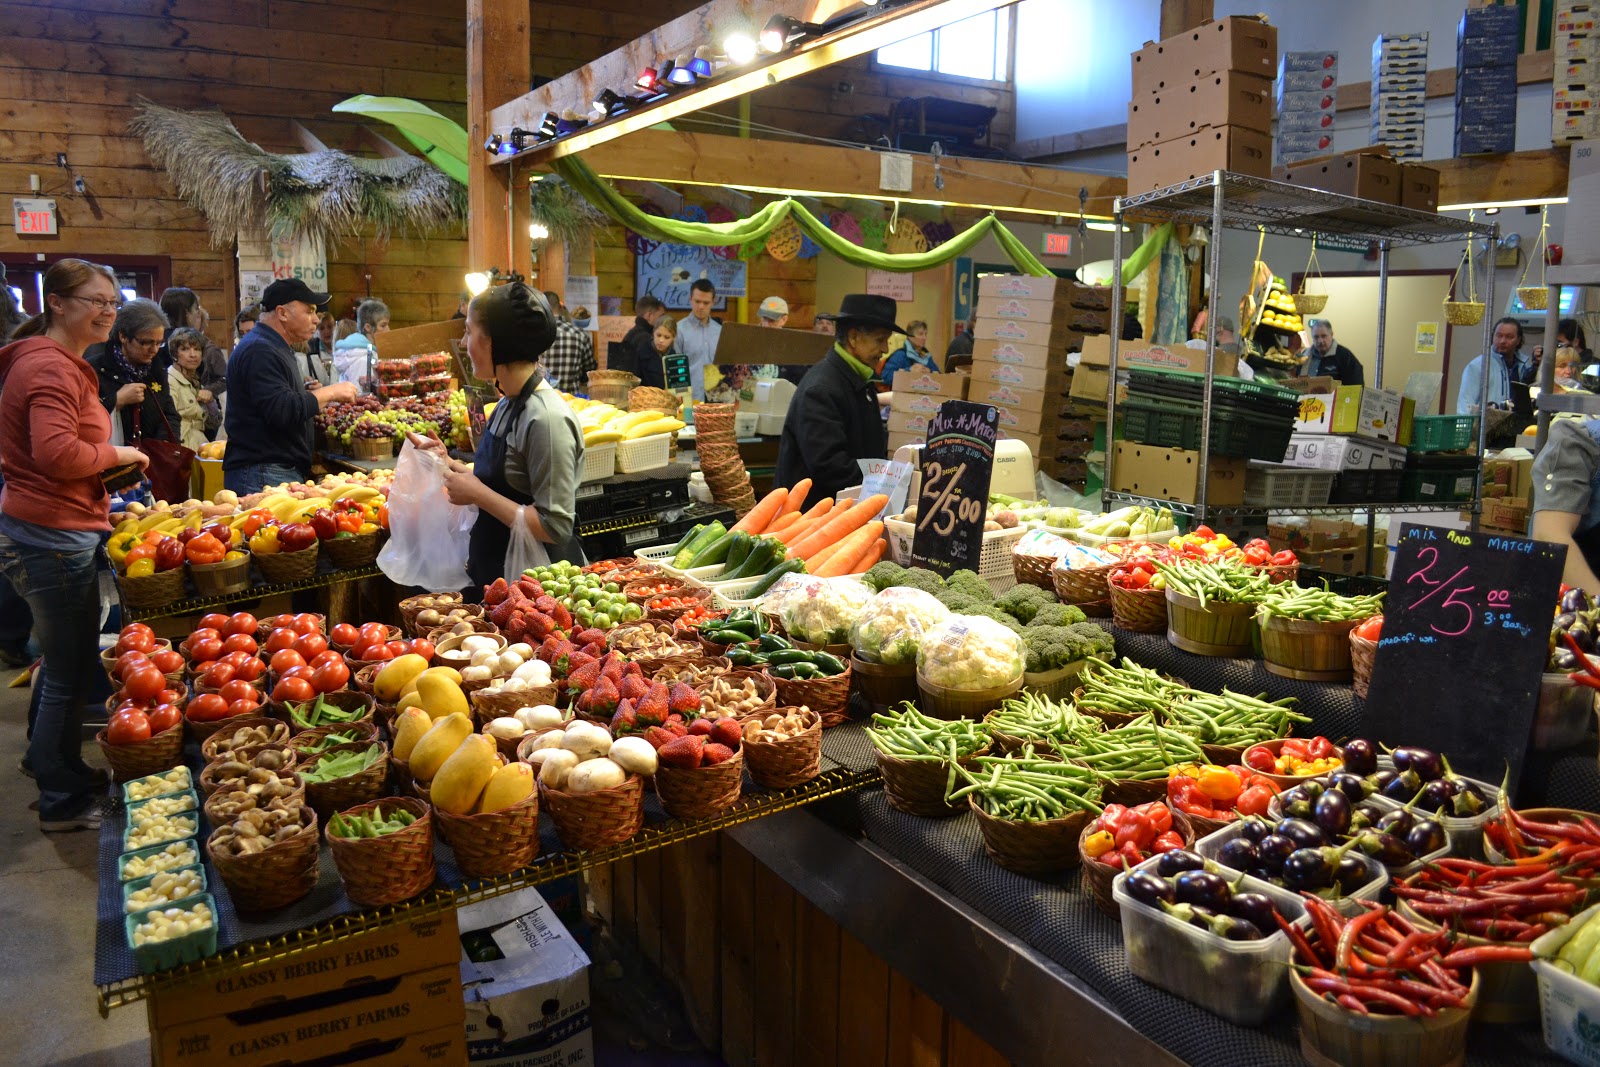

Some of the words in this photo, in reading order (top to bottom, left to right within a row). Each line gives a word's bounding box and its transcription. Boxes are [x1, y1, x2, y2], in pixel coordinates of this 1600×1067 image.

[1577, 148, 1592, 158] 500
[21, 211, 50, 232] EXIT
[1047, 233, 1069, 253] EXIT
[951, 445, 965, 453] STOP
[966, 447, 982, 459] SHOP
[1447, 530, 1472, 545] AND
[1488, 538, 1534, 553] MATCH
[410, 919, 442, 930] Consumer
[216, 970, 278, 994] CLASSY
[283, 956, 339, 980] BERRY
[344, 942, 400, 965] FARMS
[560, 1007, 570, 1018] OF
[229, 1032, 292, 1057] CLASSY
[296, 1016, 352, 1041] BERRY
[356, 1002, 411, 1027] FARMS
[523, 1052, 553, 1066] PACKED
[553, 1049, 562, 1060] BY
[567, 1048, 586, 1066] INC.
